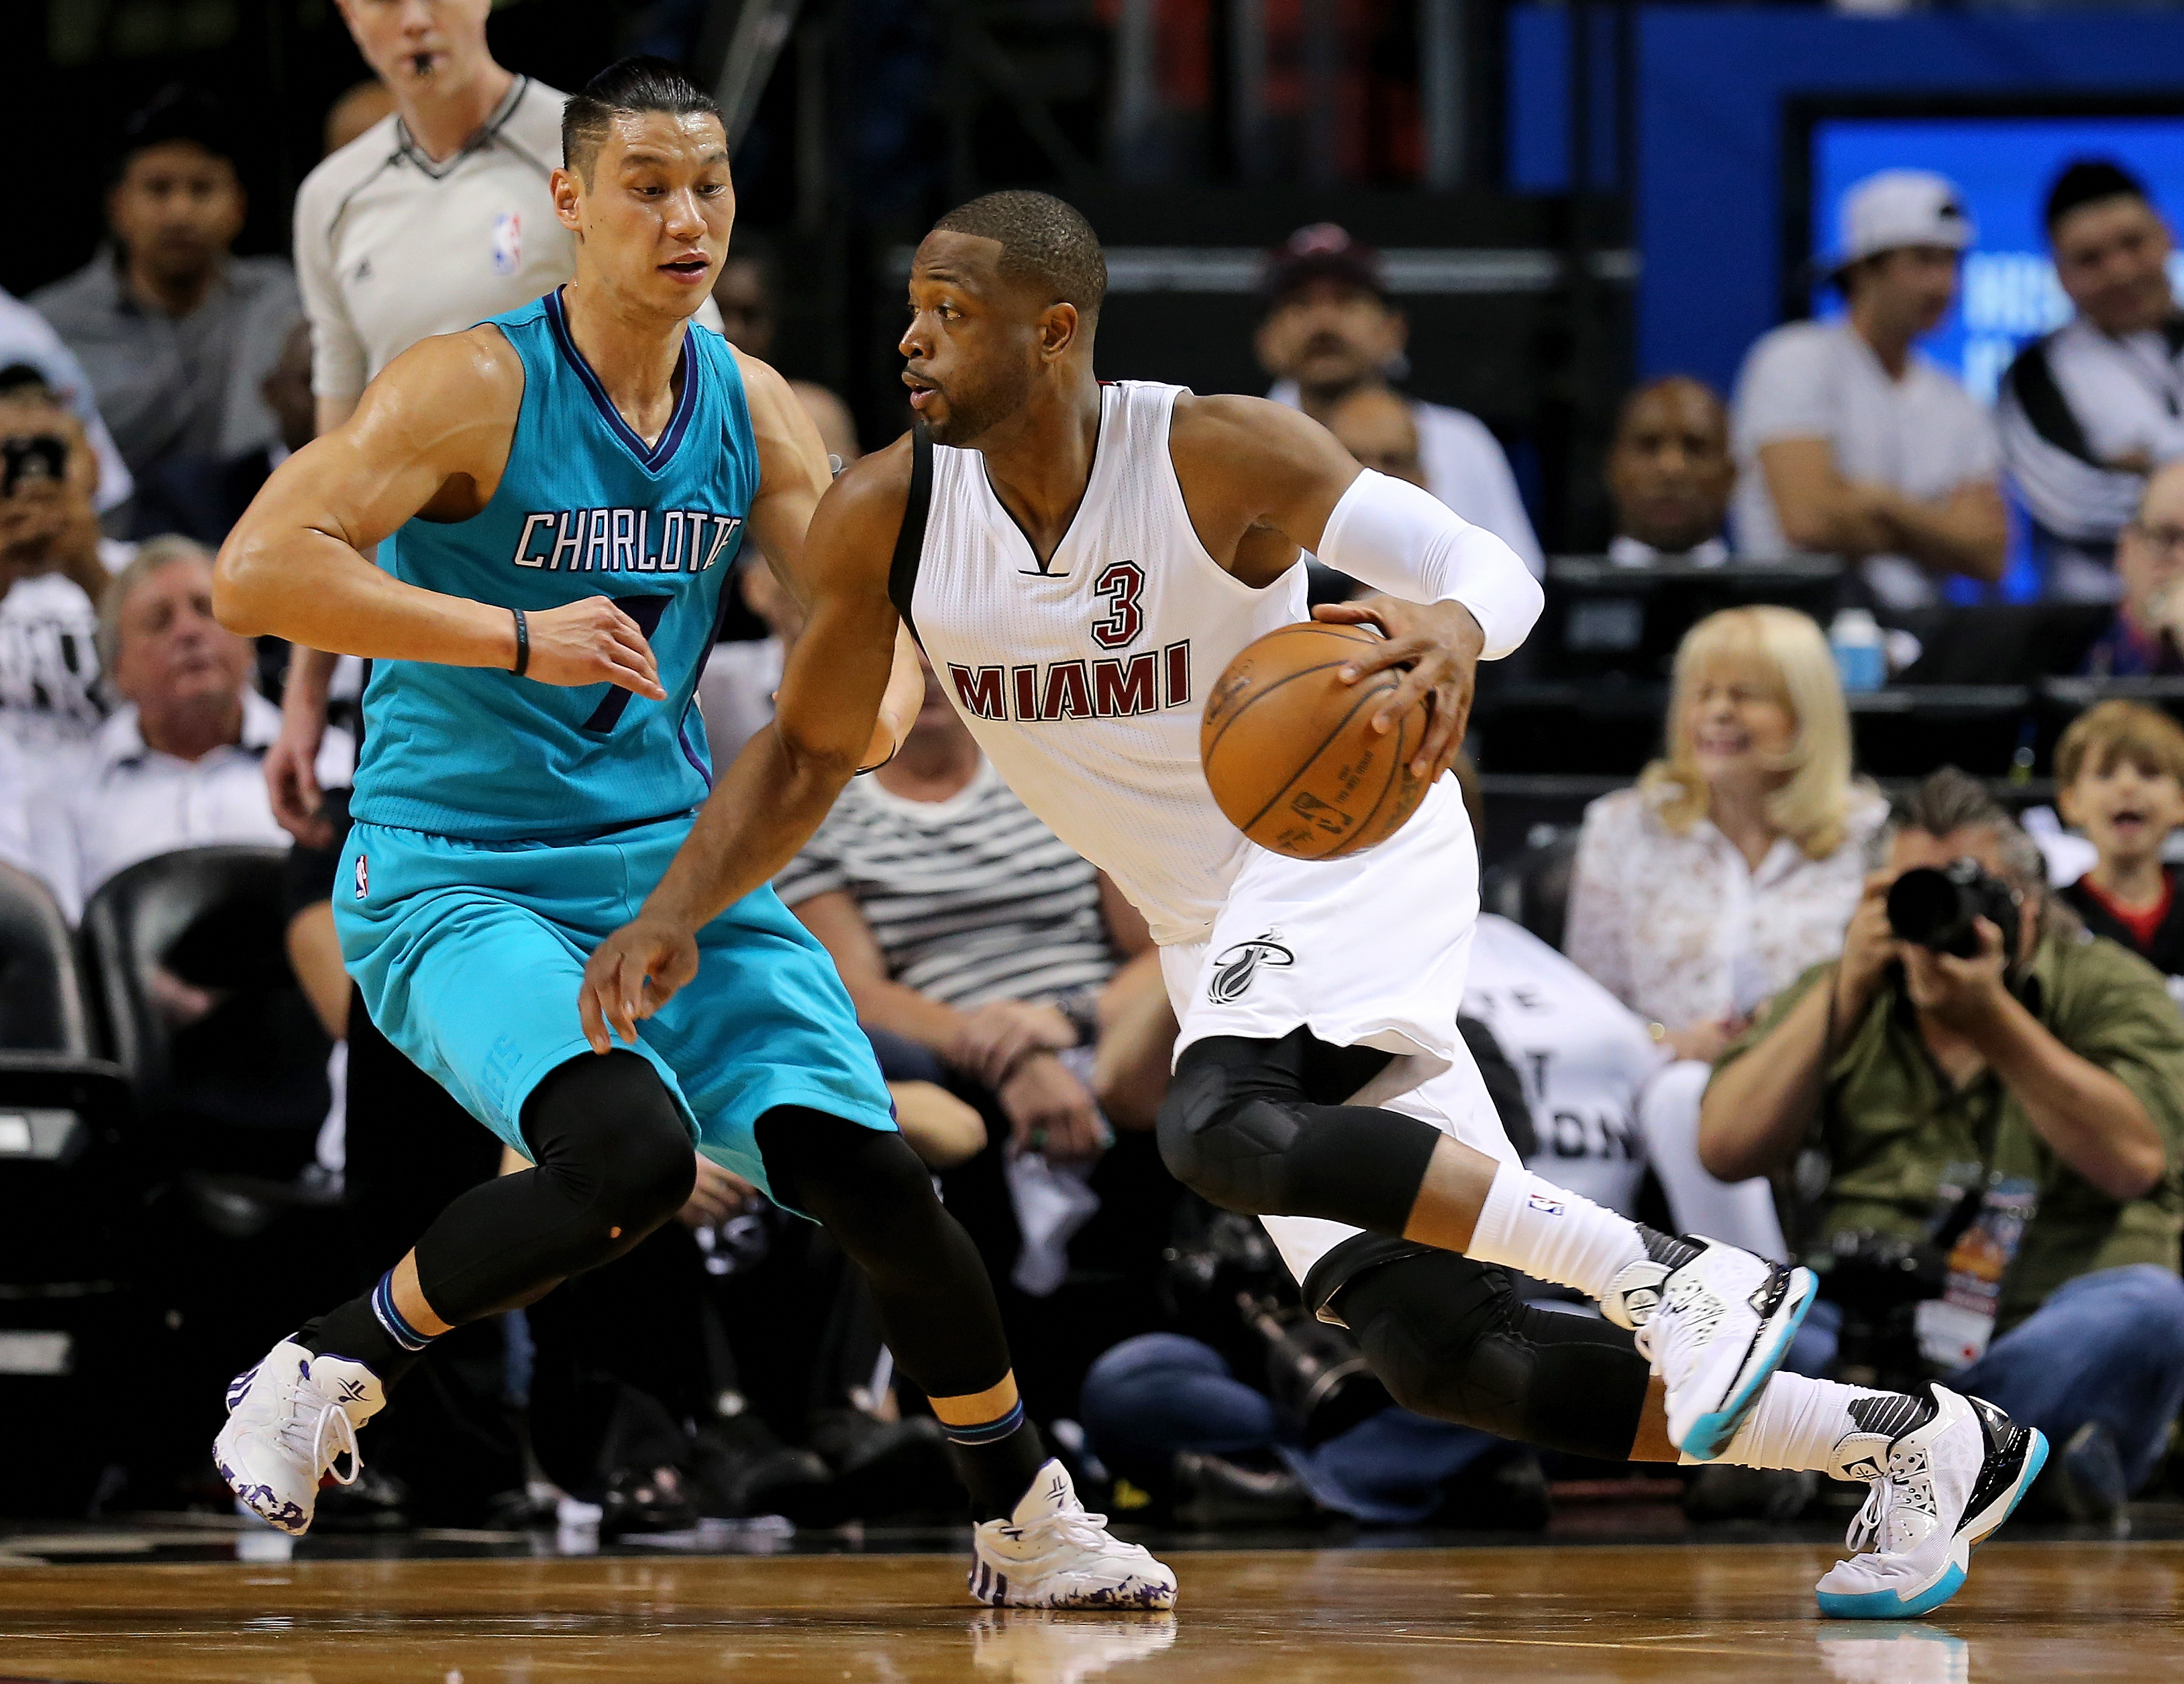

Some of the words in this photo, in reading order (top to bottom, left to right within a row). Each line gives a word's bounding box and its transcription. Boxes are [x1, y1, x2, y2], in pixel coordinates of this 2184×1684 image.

[513, 506, 742, 573] CHARLOTTE
[1091, 560, 1145, 650] 3
[581, 593, 675, 734] 7
[947, 638, 1191, 723] MIAMI
